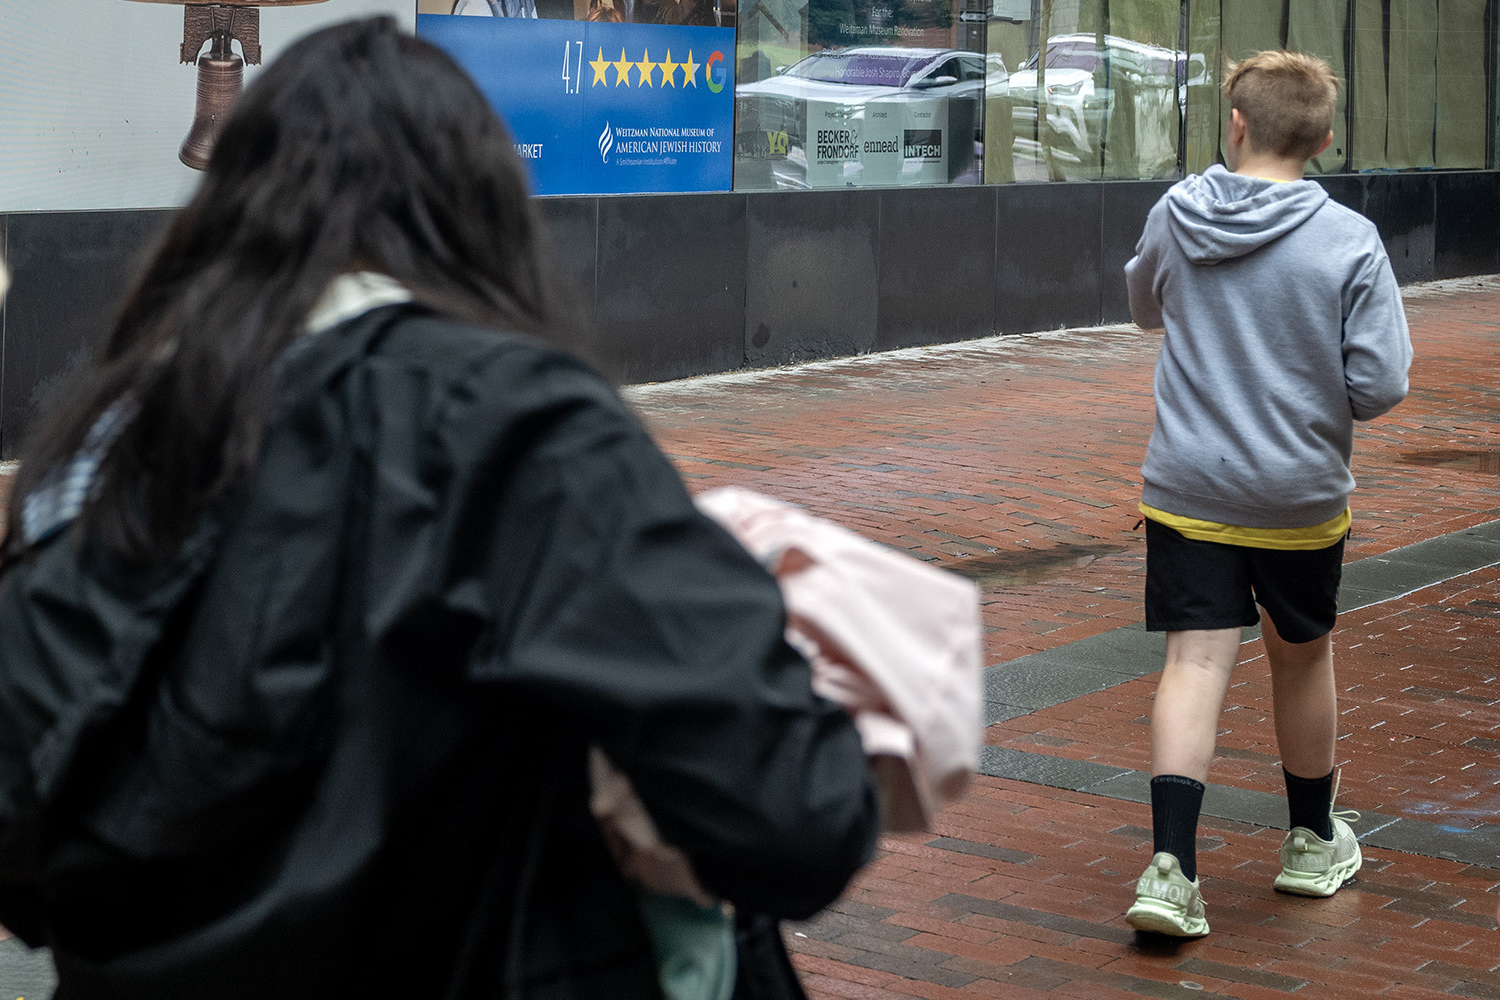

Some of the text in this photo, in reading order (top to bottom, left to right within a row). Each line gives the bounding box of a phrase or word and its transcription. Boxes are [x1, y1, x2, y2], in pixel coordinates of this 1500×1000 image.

[839, 23, 925, 36] Weitzman Museum Renovation
[562, 41, 583, 94] 4.7
[866, 67, 878, 79] Josh
[616, 127, 714, 137] WEITZMAN NATIONAL MUSEUM OF
[817, 129, 859, 145] BECKER &
[616, 141, 722, 155] AMERICAN JEWISH HISTORY
[864, 136, 898, 153] ennead
[905, 145, 941, 157] INTECH
[817, 145, 859, 159] FRONDORF
